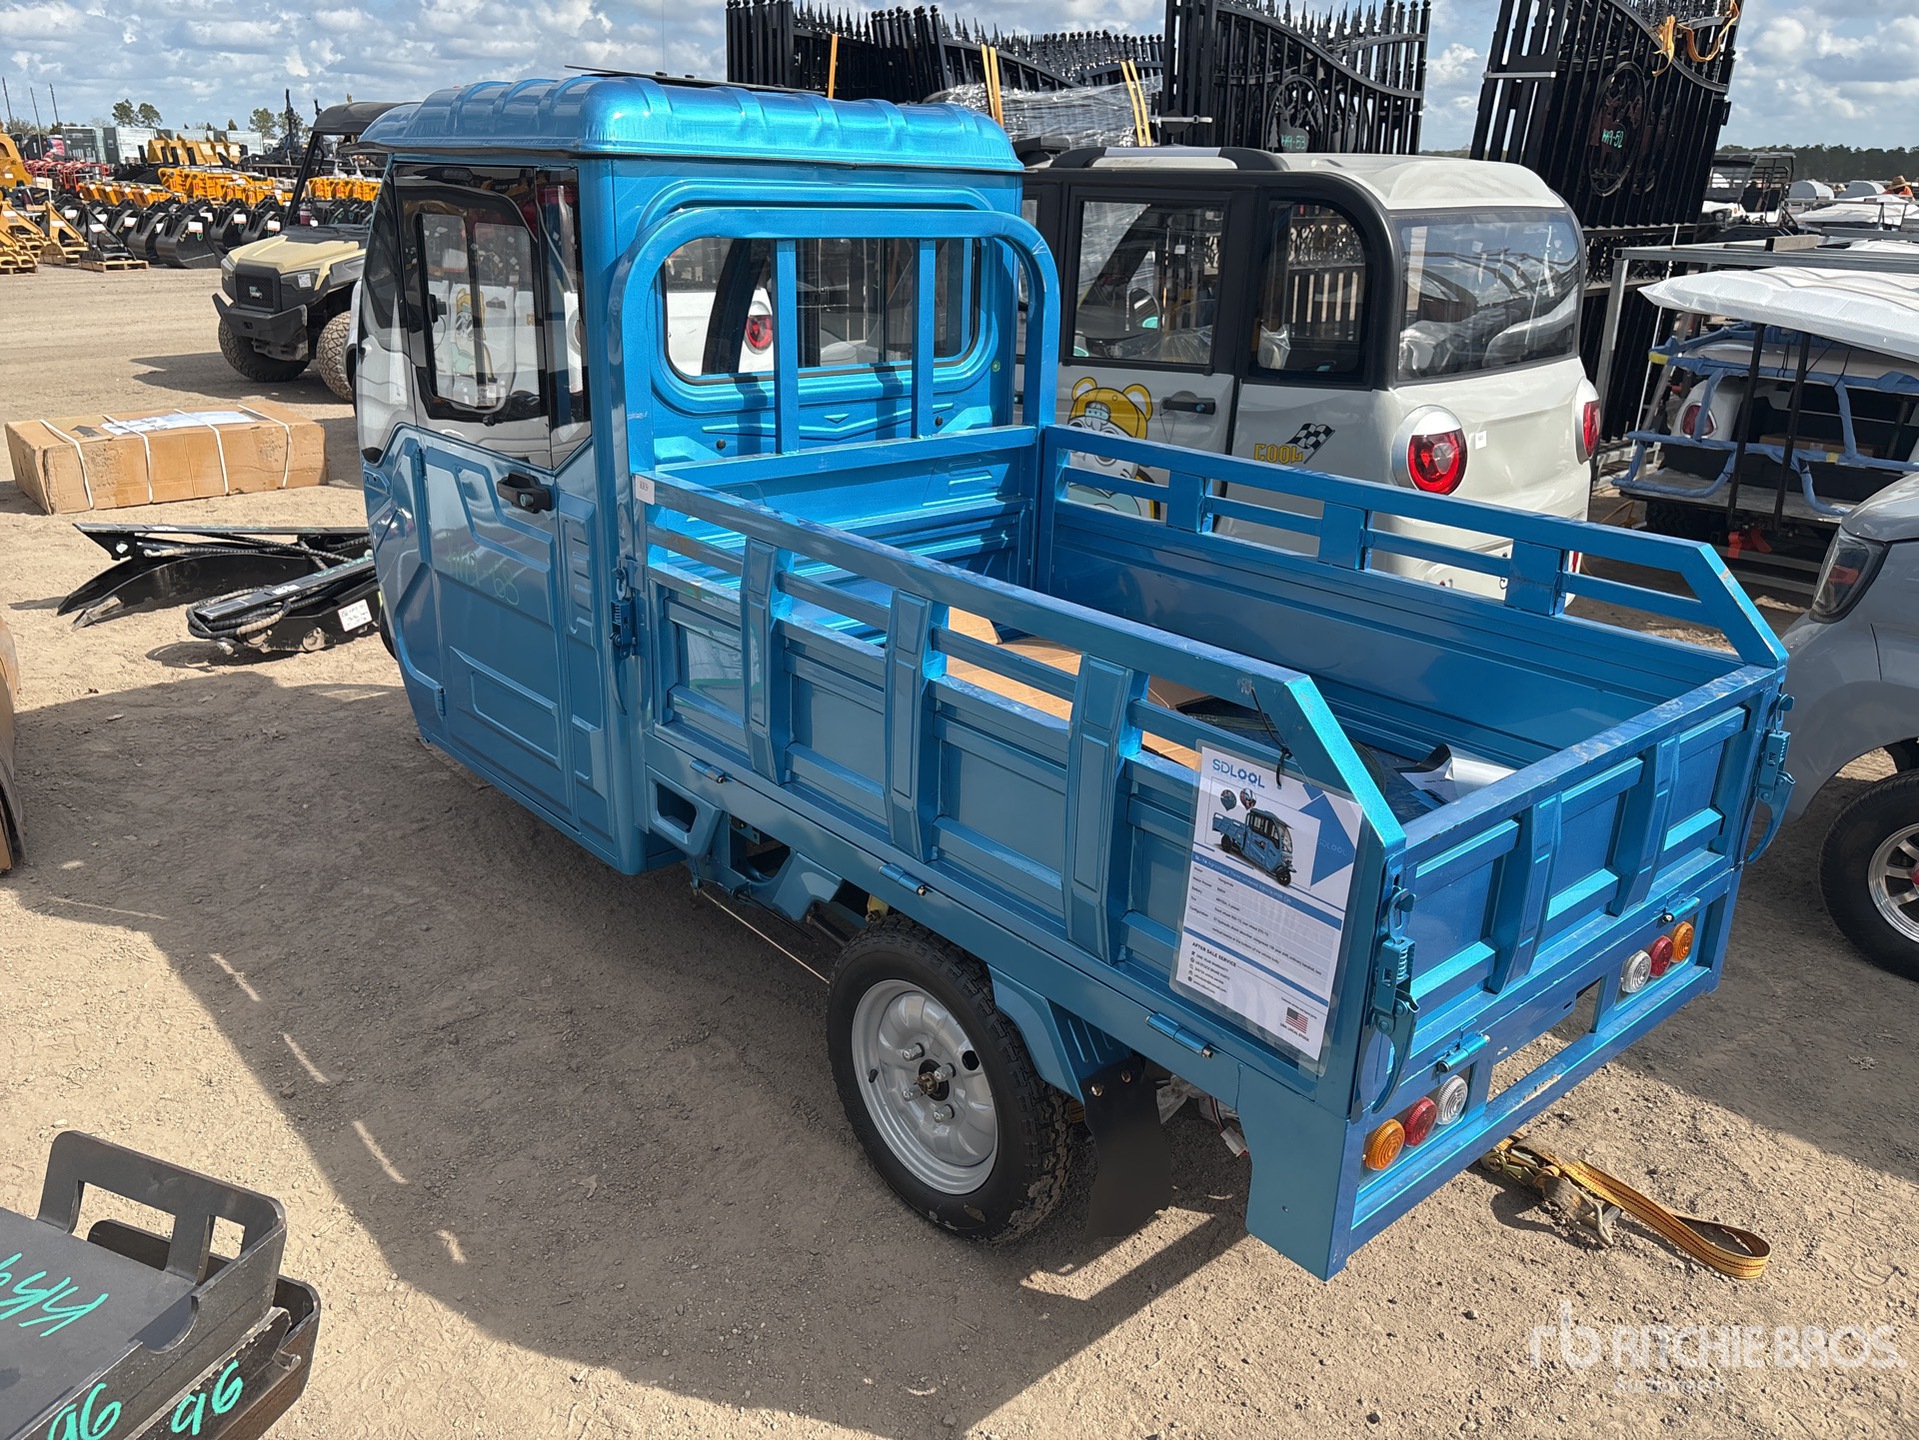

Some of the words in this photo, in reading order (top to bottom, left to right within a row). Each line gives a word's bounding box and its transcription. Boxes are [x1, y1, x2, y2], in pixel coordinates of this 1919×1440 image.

[1254, 443, 1303, 464] COOL
[1212, 757, 1266, 788] SDLOOL
[1192, 941, 1205, 951] AFTER
[1206, 948, 1217, 957] SALE
[1218, 954, 1236, 967] SERVICE
